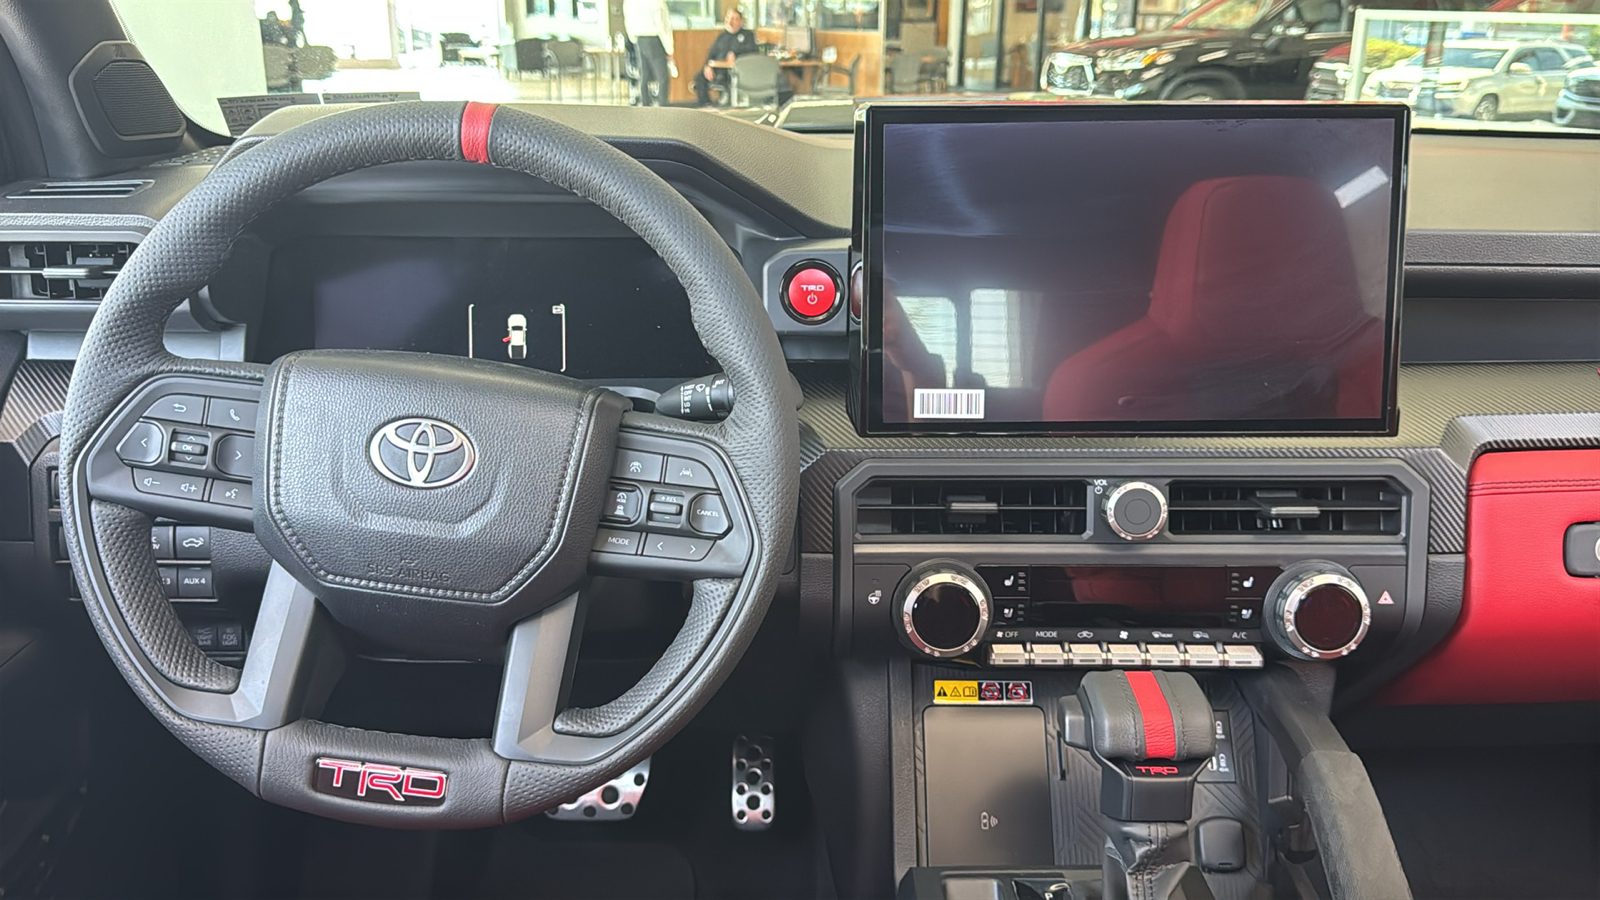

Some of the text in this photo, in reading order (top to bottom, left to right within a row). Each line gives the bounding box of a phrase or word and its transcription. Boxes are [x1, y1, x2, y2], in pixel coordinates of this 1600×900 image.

[800, 284, 825, 292] TRD
[182, 444, 194, 452] OK
[696, 508, 720, 518] CANCEL
[607, 536, 630, 546] MODE
[366, 563, 450, 583] SRS AIRBAG
[183, 577, 206, 585] AUX 4
[1004, 630, 1019, 638] OFF
[1035, 630, 1059, 638] MODE
[1231, 631, 1248, 640] A/C
[1134, 765, 1179, 776] TRD
[315, 756, 449, 802] TRD
